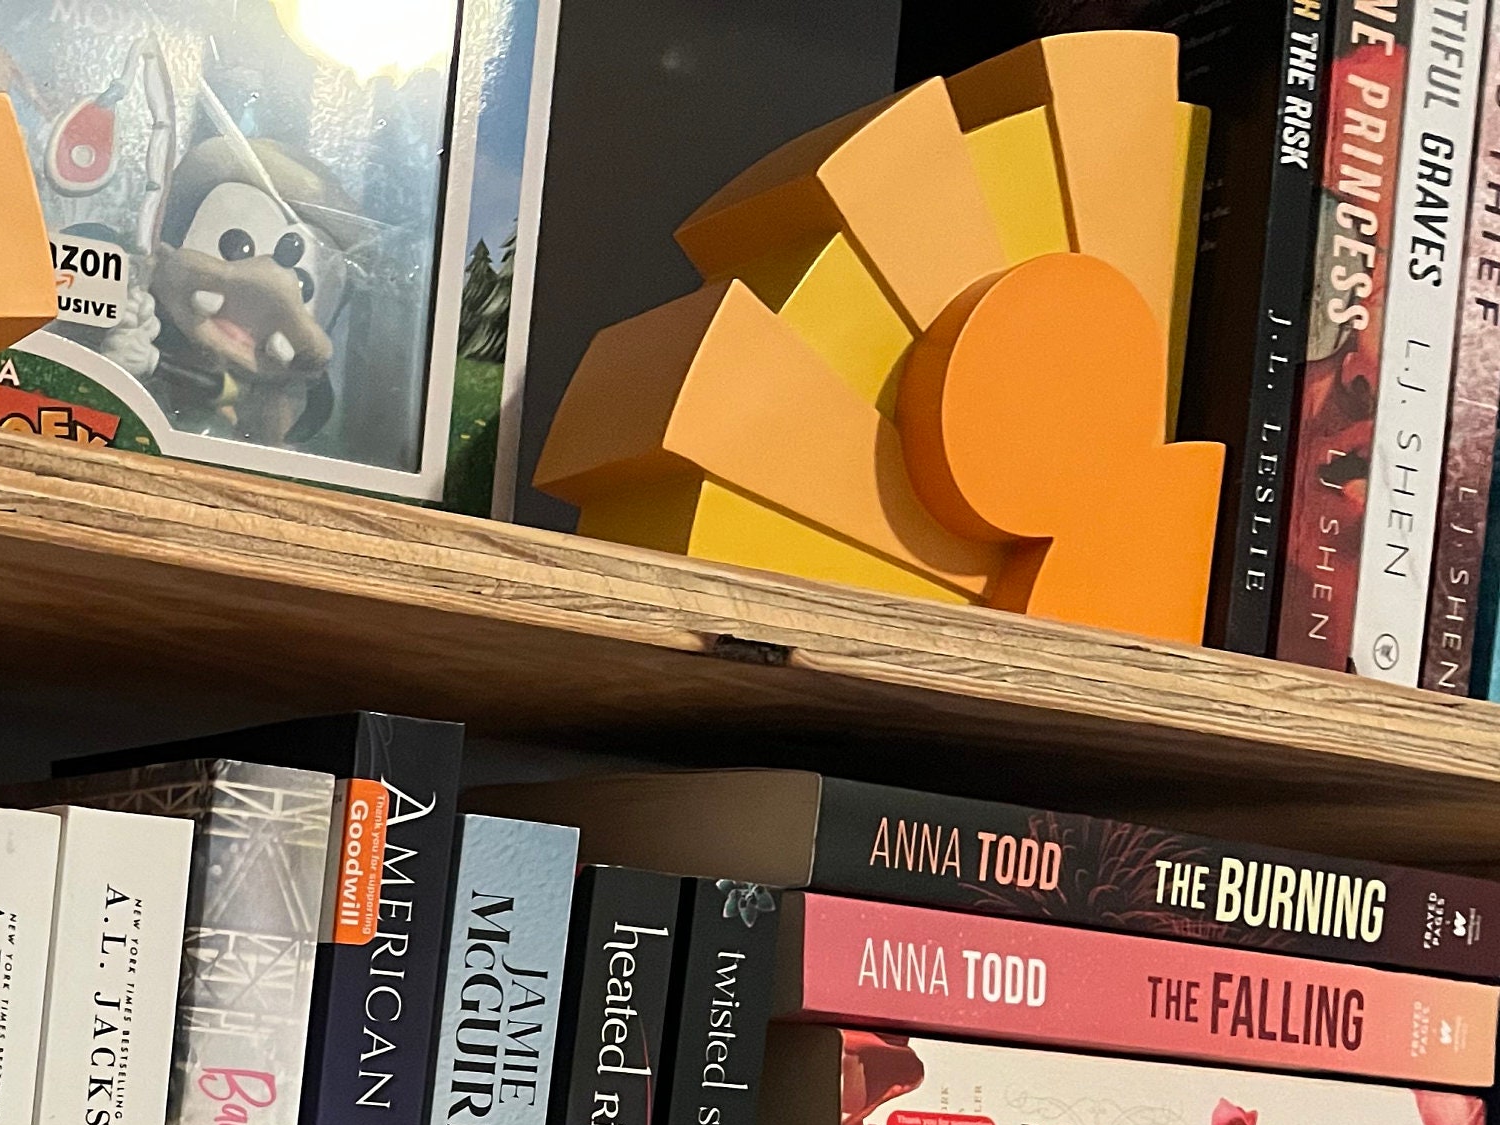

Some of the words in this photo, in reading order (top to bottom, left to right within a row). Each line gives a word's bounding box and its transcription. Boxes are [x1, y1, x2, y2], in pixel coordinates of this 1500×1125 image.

[1287, 32, 1319, 91] THE
[1280, 96, 1313, 169] RISK
[1328, 74, 1391, 330] PRINCESS
[1408, 132, 1454, 287] GRAVES
[1245, 422, 1281, 591] LESLIE
[1384, 430, 1422, 578] SHEN
[1308, 516, 1340, 641] SHEN
[1438, 567, 1469, 688] SHEN
[132, 898, 143, 931] NEW
[340, 798, 369, 926] Goodwill
[869, 817, 961, 878] ANNA
[977, 831, 1062, 890] TODD
[1155, 860, 1210, 910] THE
[1216, 857, 1386, 943] BURNING
[2, 953, 13, 991] YORK
[7, 913, 17, 945] NEW
[127, 938, 140, 974] YORK
[355, 773, 436, 1108] AMERICAN
[123, 982, 135, 1023] TIMES
[499, 955, 549, 1107] JAMIE
[597, 921, 669, 1077] heated
[701, 949, 749, 1090] twisted
[858, 937, 948, 997] ANNA
[962, 950, 1047, 1007] TODD
[1147, 976, 1200, 1023] THE
[1210, 972, 1364, 1051] FALLING
[114, 1030, 130, 1120] BESTSELLING
